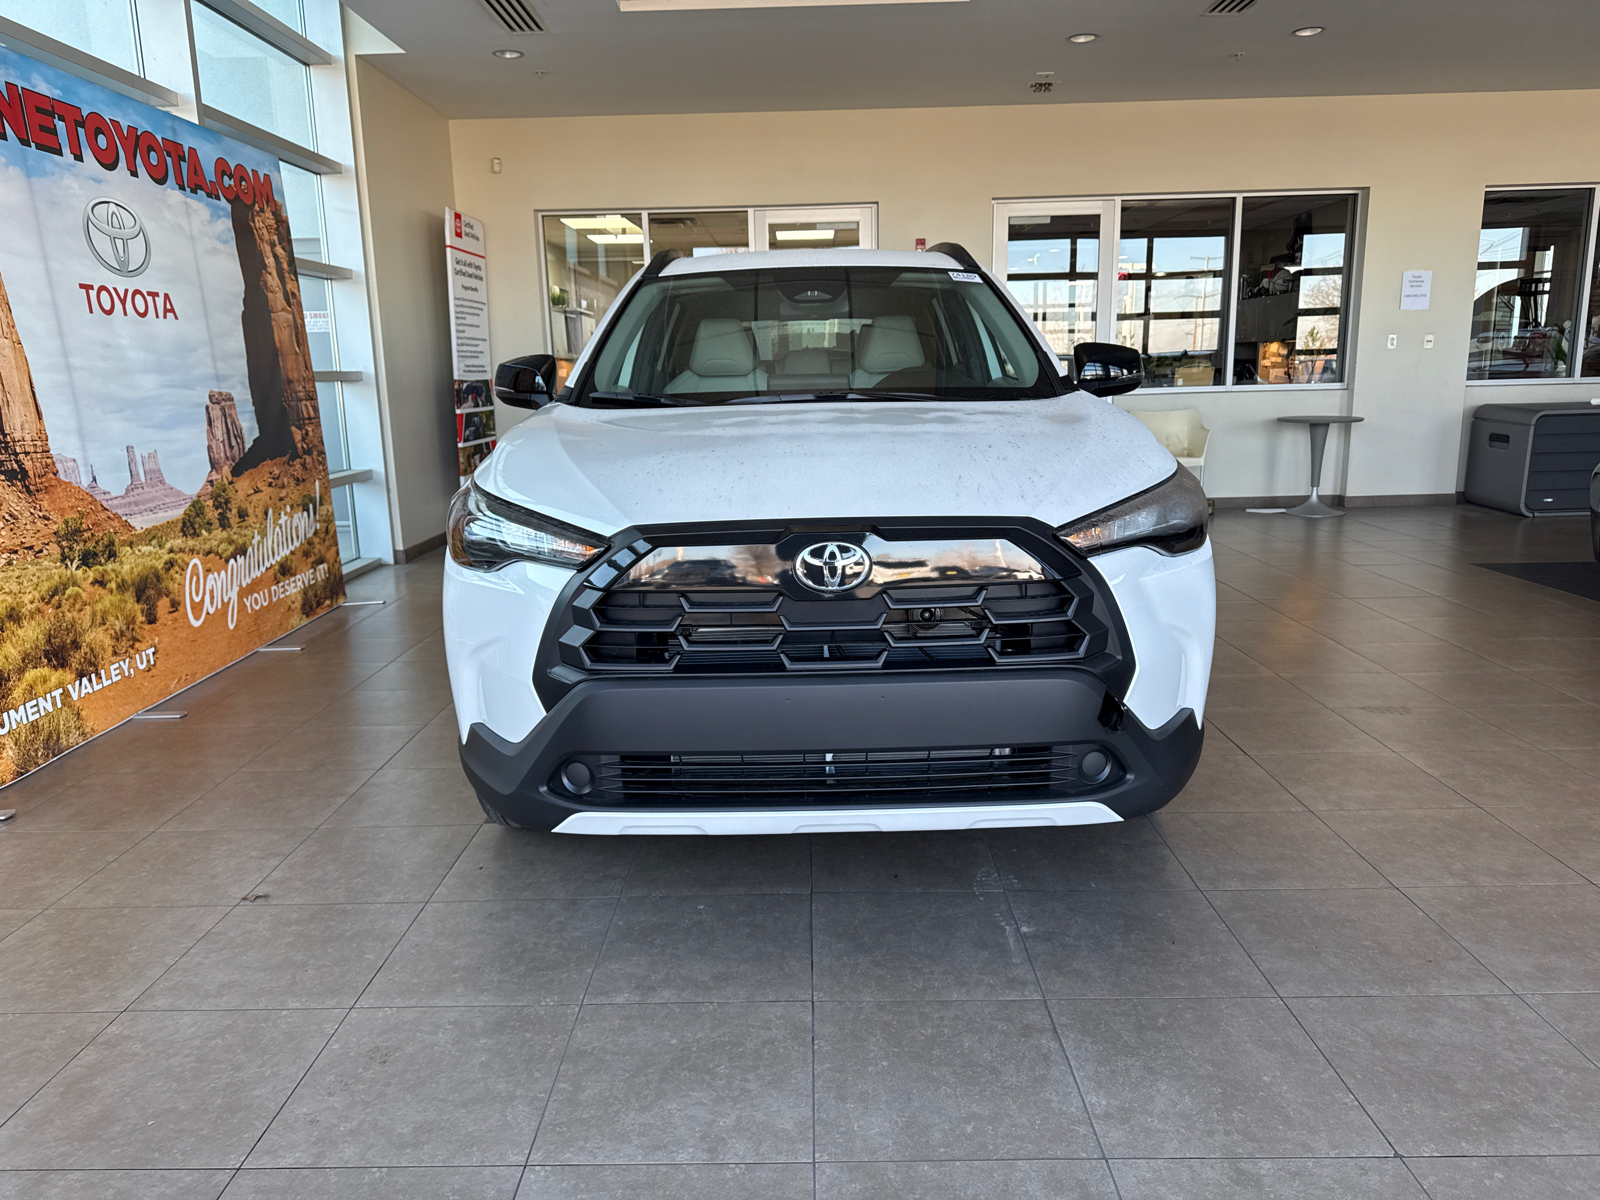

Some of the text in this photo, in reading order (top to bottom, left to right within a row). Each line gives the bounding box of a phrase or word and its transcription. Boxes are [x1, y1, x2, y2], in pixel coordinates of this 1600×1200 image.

[0, 81, 277, 212] NETOYOTA.COM
[78, 283, 179, 320] TOYOTA
[185, 479, 320, 630] Congratulations!
[243, 562, 329, 613] YOU DESERVE IT!
[66, 658, 134, 702] VALLEY,
[135, 647, 155, 670] UT
